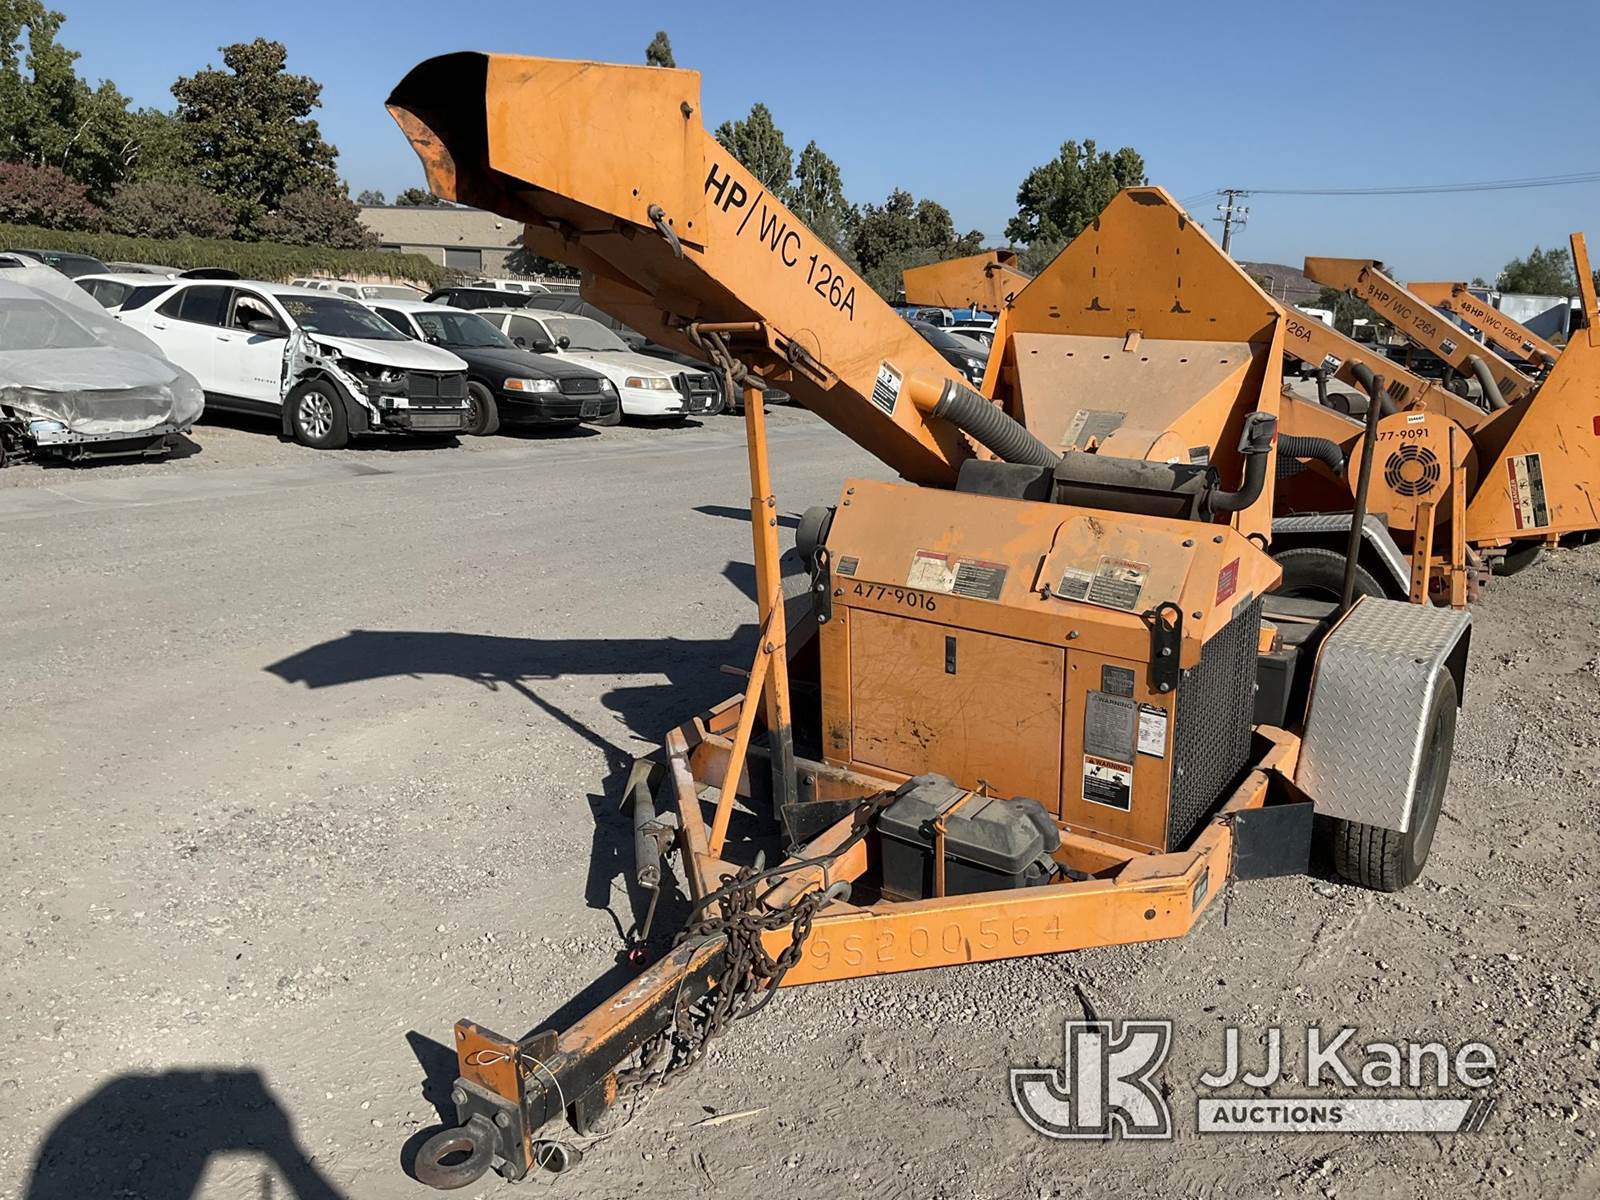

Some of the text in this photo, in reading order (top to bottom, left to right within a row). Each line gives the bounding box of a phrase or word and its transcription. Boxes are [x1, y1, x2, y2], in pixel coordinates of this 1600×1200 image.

[806, 254, 856, 322] 126A
[1412, 316, 1437, 338] 126A
[1502, 327, 1523, 343] 126A
[1375, 428, 1429, 441] 77-9091
[853, 583, 936, 611] 477-9016
